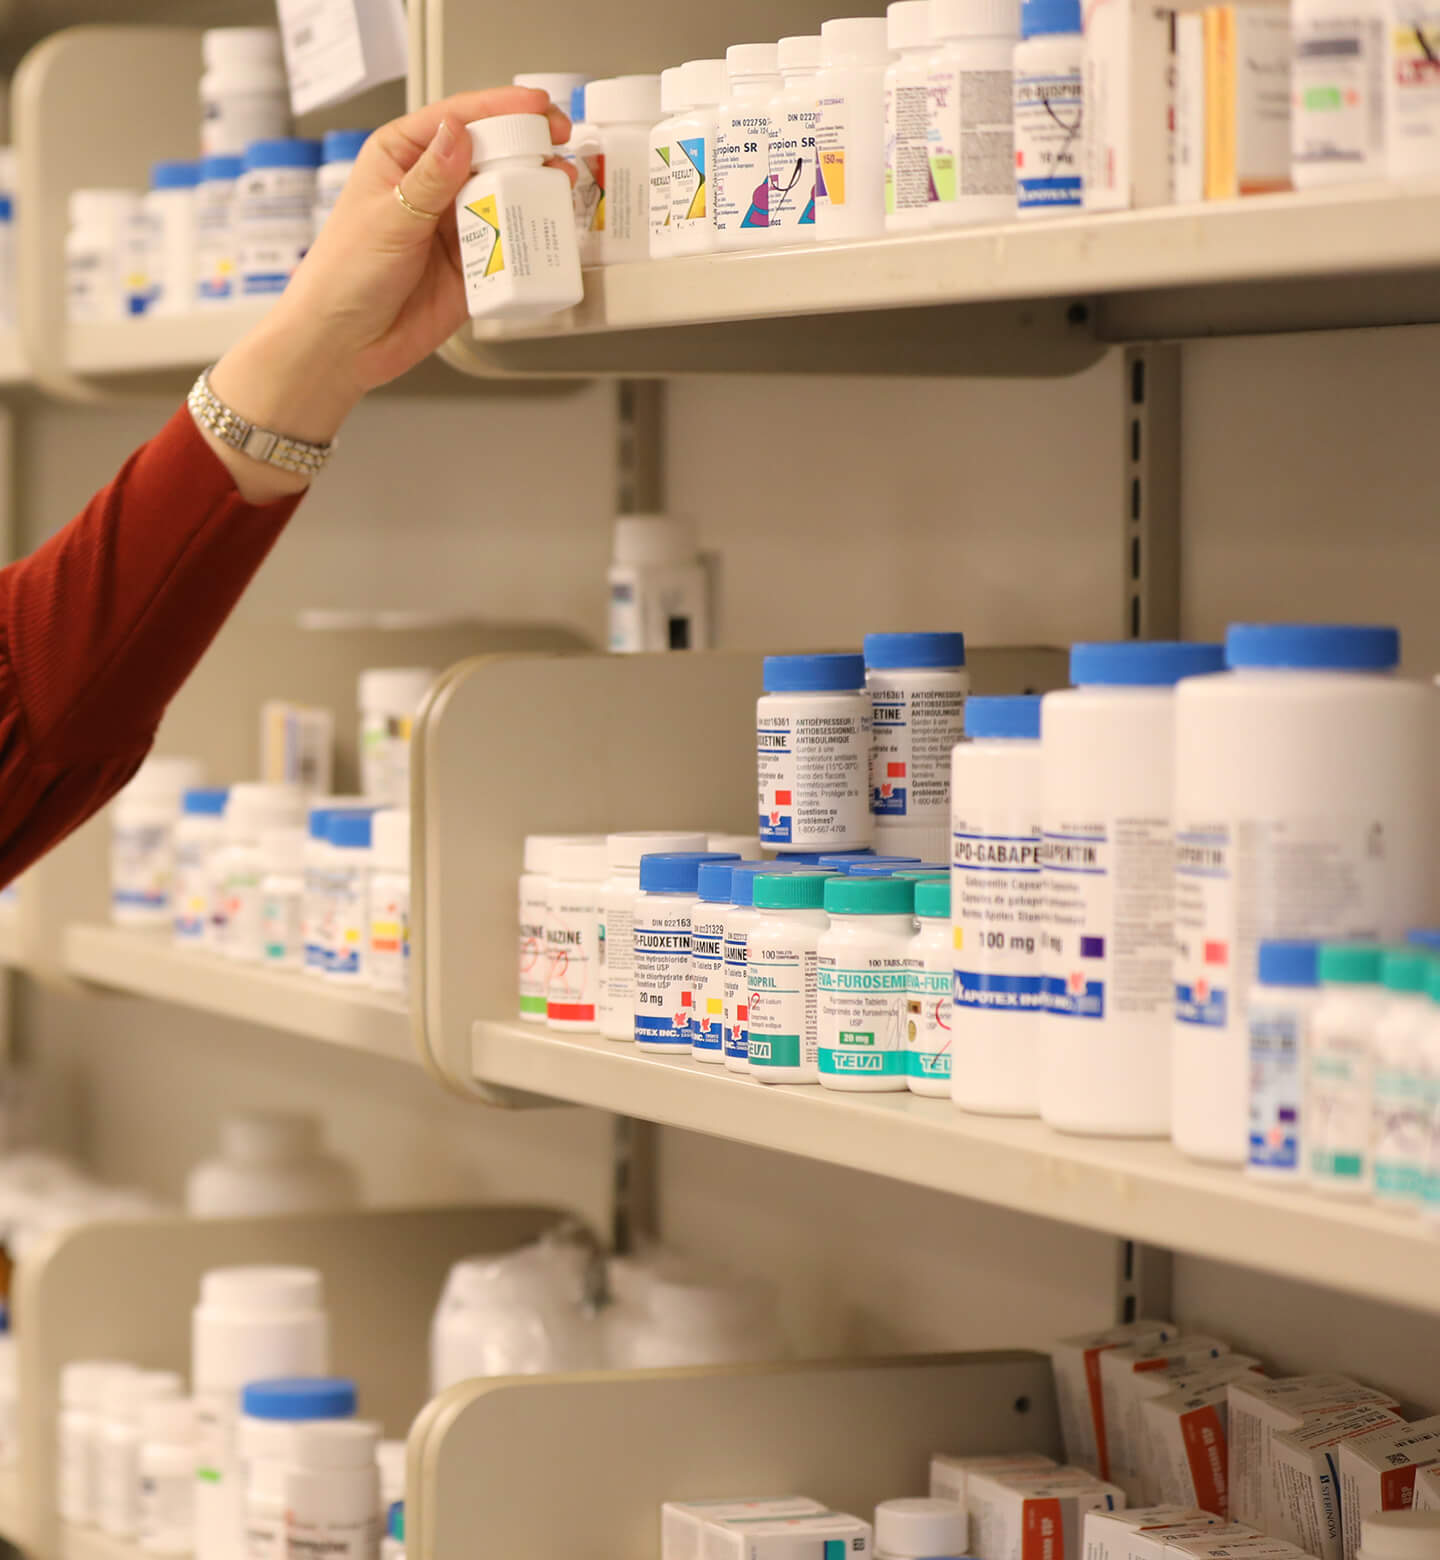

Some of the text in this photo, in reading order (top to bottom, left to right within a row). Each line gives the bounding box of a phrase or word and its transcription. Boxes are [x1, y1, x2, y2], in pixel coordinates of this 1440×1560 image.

[732, 118, 768, 127] DIN 022750
[788, 112, 816, 122] DIN 0227
[744, 142, 758, 153] SR
[801, 136, 816, 148] SR
[823, 154, 836, 165] 150
[664, 918, 692, 928] 022163
[979, 931, 1035, 954] 100 mg
[762, 950, 776, 960] 100
[869, 959, 882, 967] 100
[640, 992, 664, 1007] 20 mg
[843, 1033, 870, 1046] 20 mg
[834, 1053, 881, 1069] TEVA
